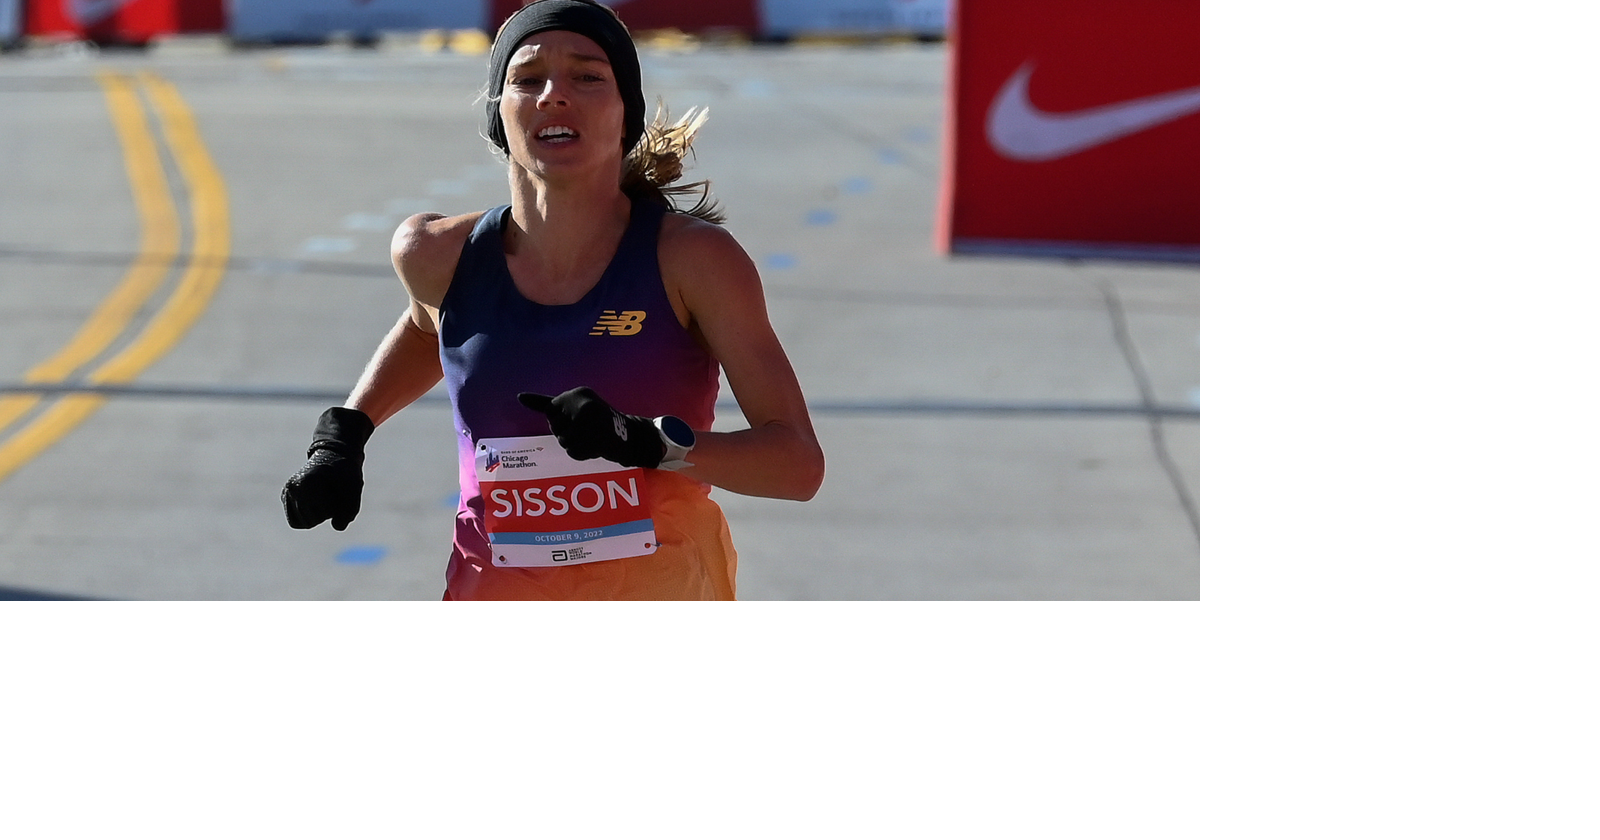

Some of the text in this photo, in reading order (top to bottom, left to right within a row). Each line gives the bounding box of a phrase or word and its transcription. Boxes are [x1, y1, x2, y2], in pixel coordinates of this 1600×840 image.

[501, 455, 528, 463] Chicago
[490, 477, 640, 518] SISSON
[534, 530, 603, 542] OCTOBER 9, 2022
